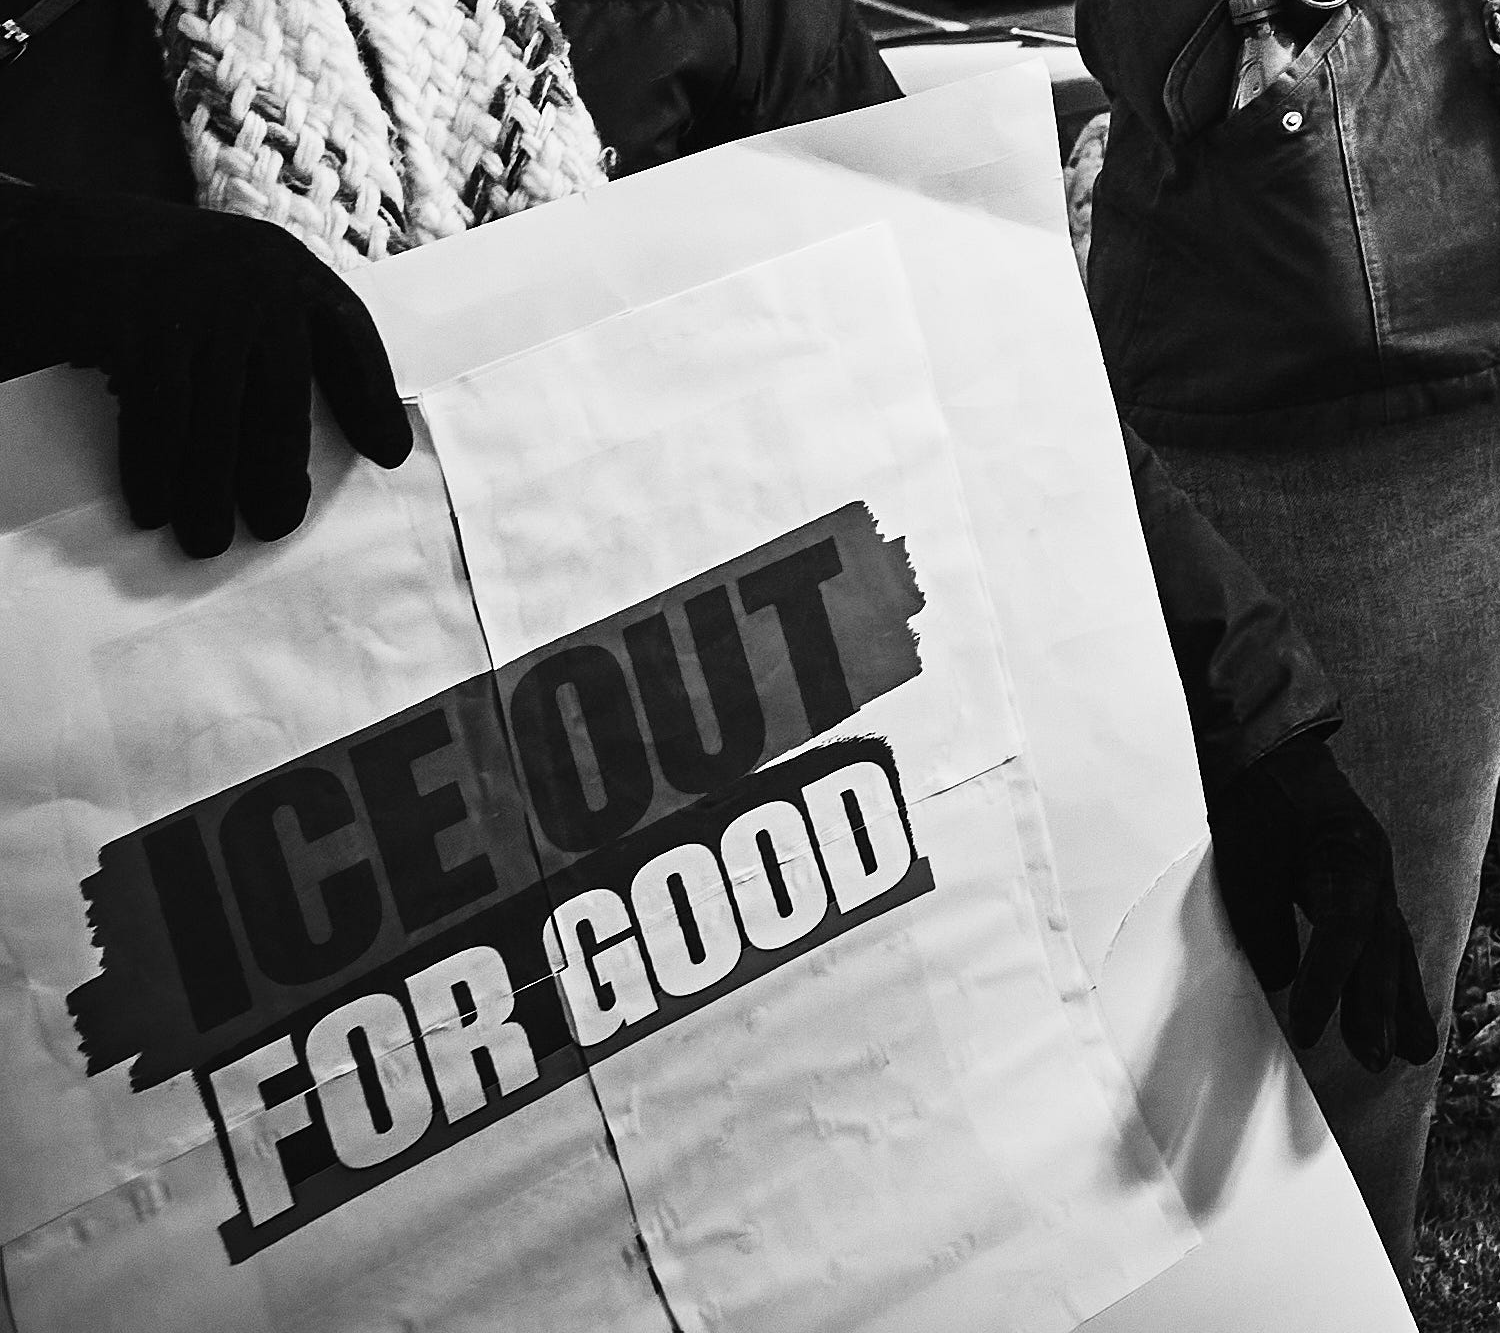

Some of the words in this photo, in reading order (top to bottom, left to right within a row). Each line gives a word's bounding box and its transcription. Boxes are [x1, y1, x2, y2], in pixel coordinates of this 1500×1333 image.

[140, 708, 498, 1035] ICE
[508, 535, 861, 854] OUT
[207, 944, 542, 1229] FOR
[541, 760, 915, 1049] GOOD
